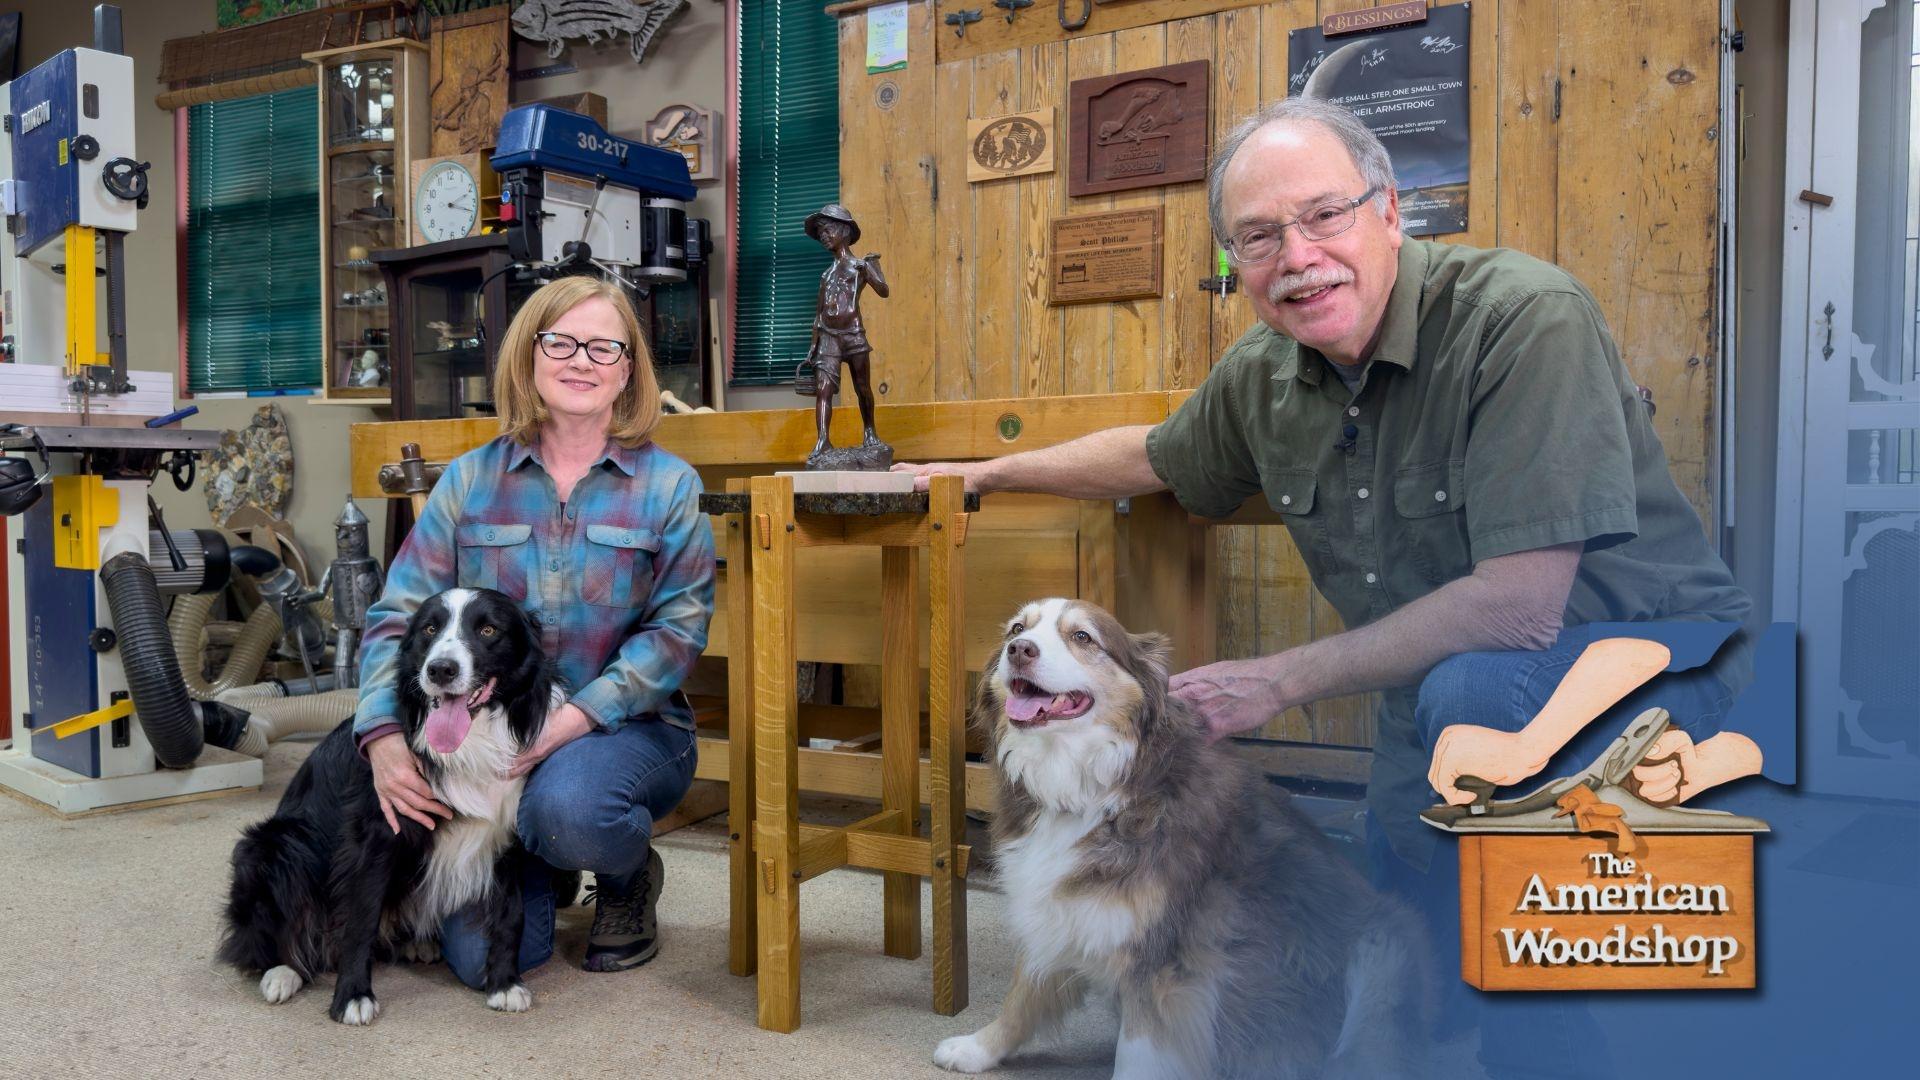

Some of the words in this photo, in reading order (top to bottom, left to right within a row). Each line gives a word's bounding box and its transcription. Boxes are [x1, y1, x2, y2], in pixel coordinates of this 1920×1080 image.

[1335, 6, 1413, 30] BLESSINGS
[1328, 97, 1344, 106] ONE
[1346, 94, 1370, 103] SMALL
[1371, 91, 1391, 99] STEP,
[1393, 88, 1410, 97] ONE
[1411, 85, 1436, 94] SMALL
[1437, 81, 1463, 90] TOWN
[1353, 107, 1374, 117] NEIL
[1376, 99, 1435, 114] ARMSTRONG
[1418, 119, 1447, 128] anniversary
[578, 132, 629, 158] 30-217
[447, 171, 455, 181] 12
[430, 189, 437, 199] 10
[468, 184, 473, 193] 2
[461, 226, 466, 236] 5
[1080, 239, 1099, 247] Scott
[1101, 236, 1129, 245] Phillips
[34, 615, 42, 666] 10-353
